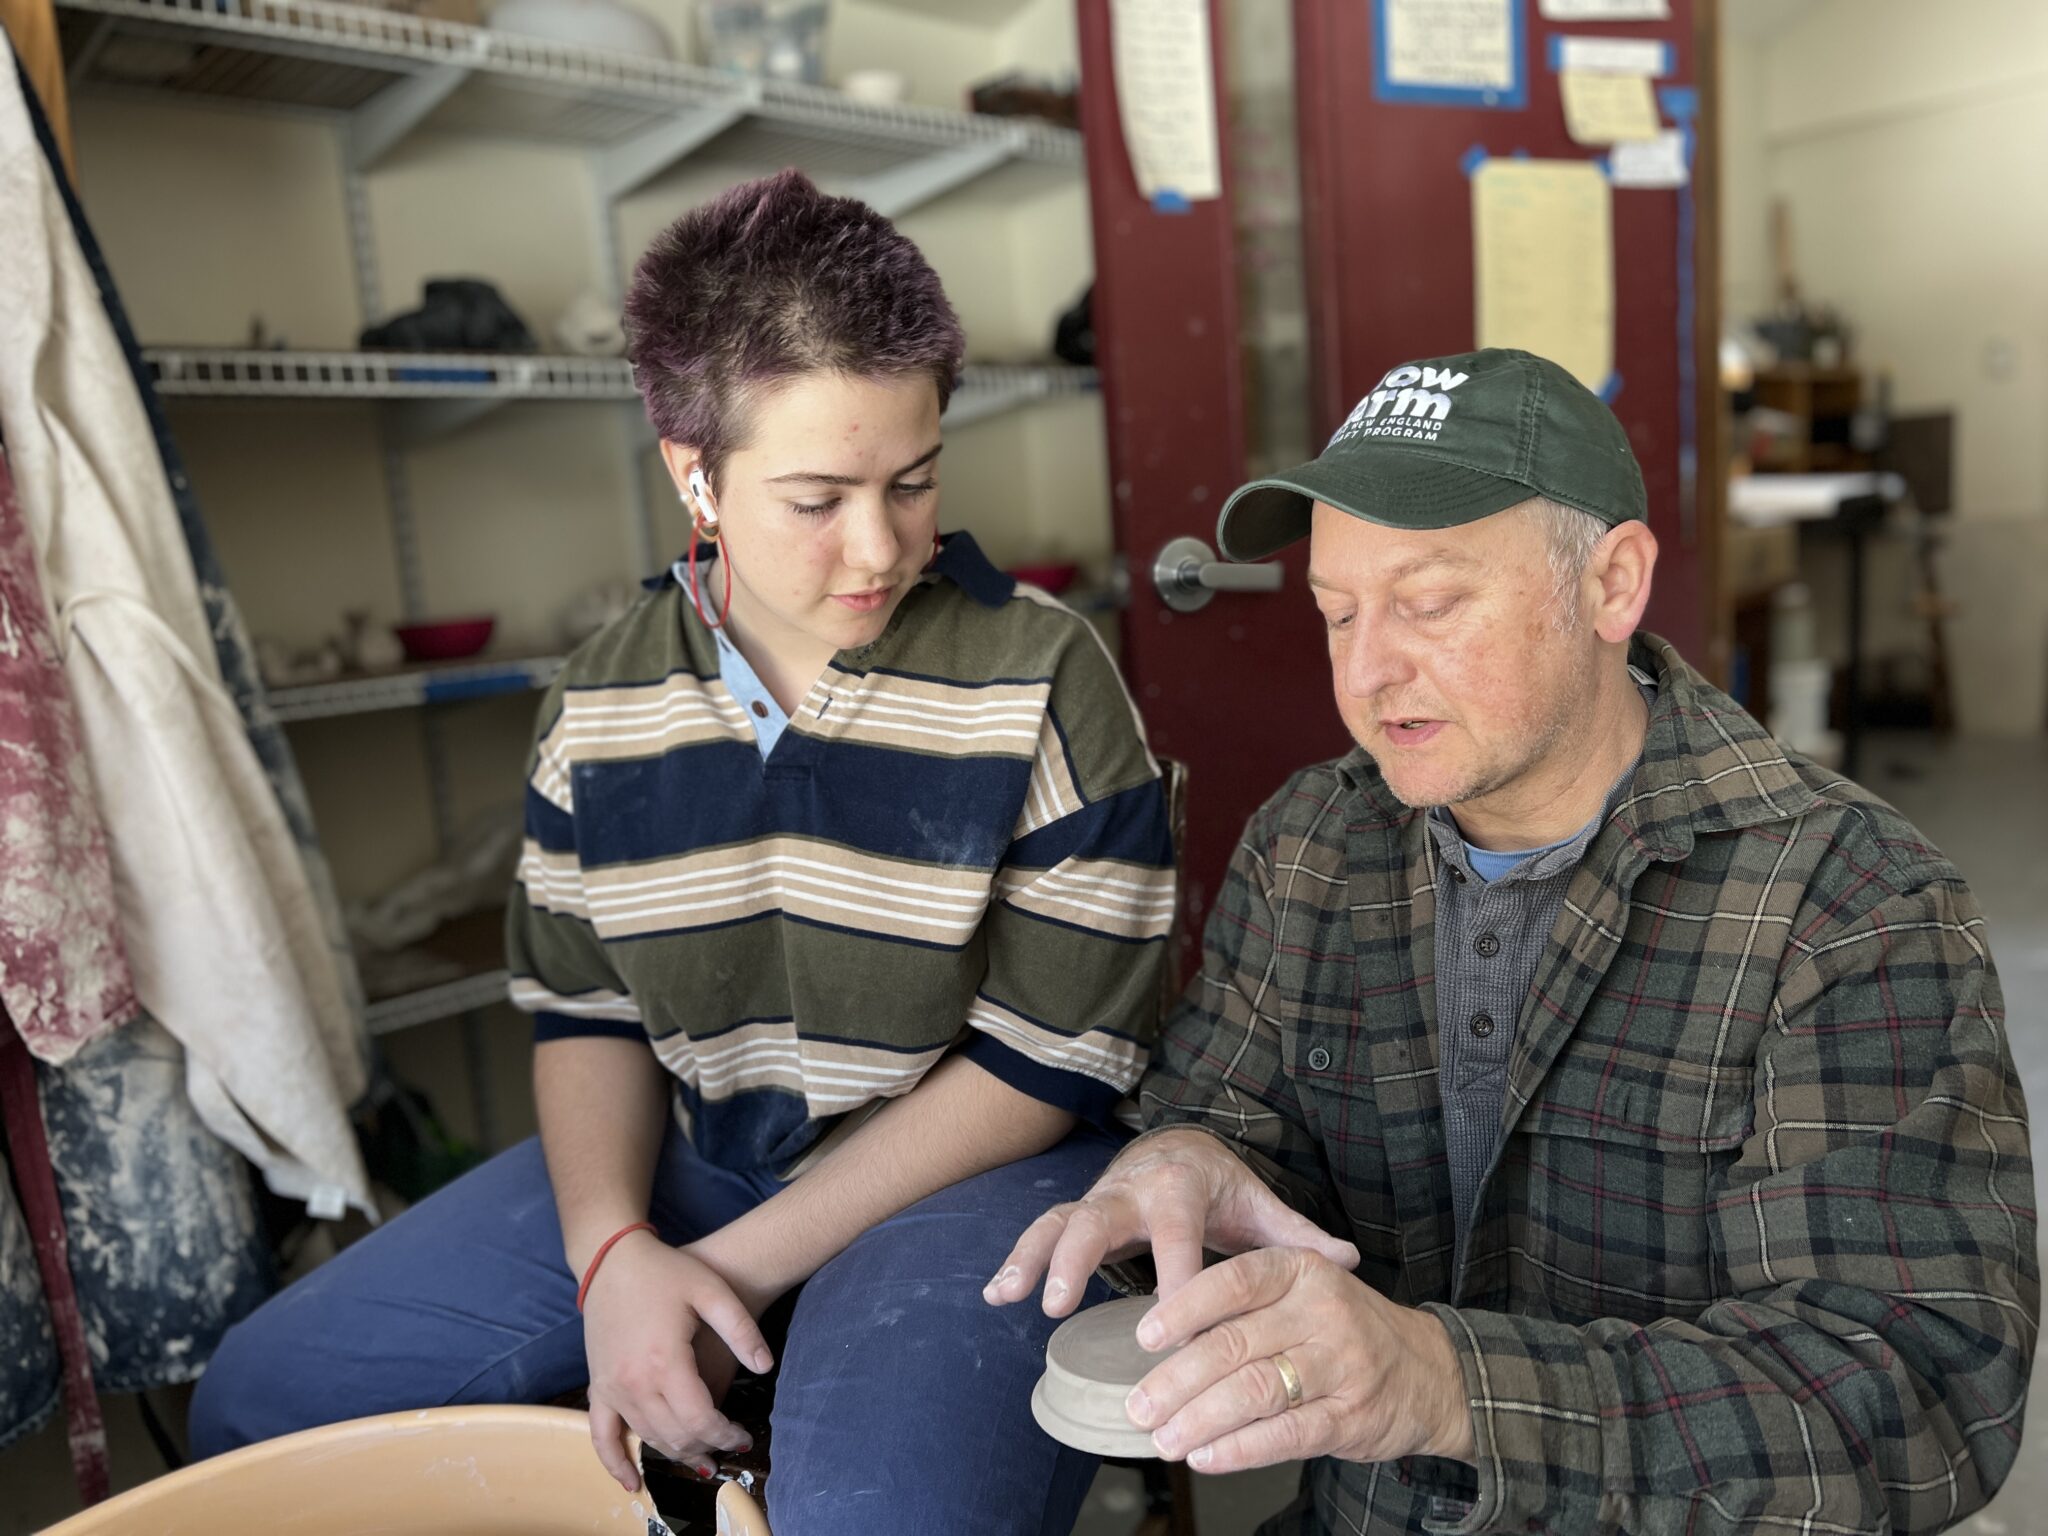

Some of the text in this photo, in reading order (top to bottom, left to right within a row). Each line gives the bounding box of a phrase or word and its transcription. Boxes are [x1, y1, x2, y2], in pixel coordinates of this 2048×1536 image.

[1349, 387, 1452, 422] arm
[1351, 417, 1443, 431] NEW ENGLAND
[1363, 427, 1438, 442] PROGRAM
